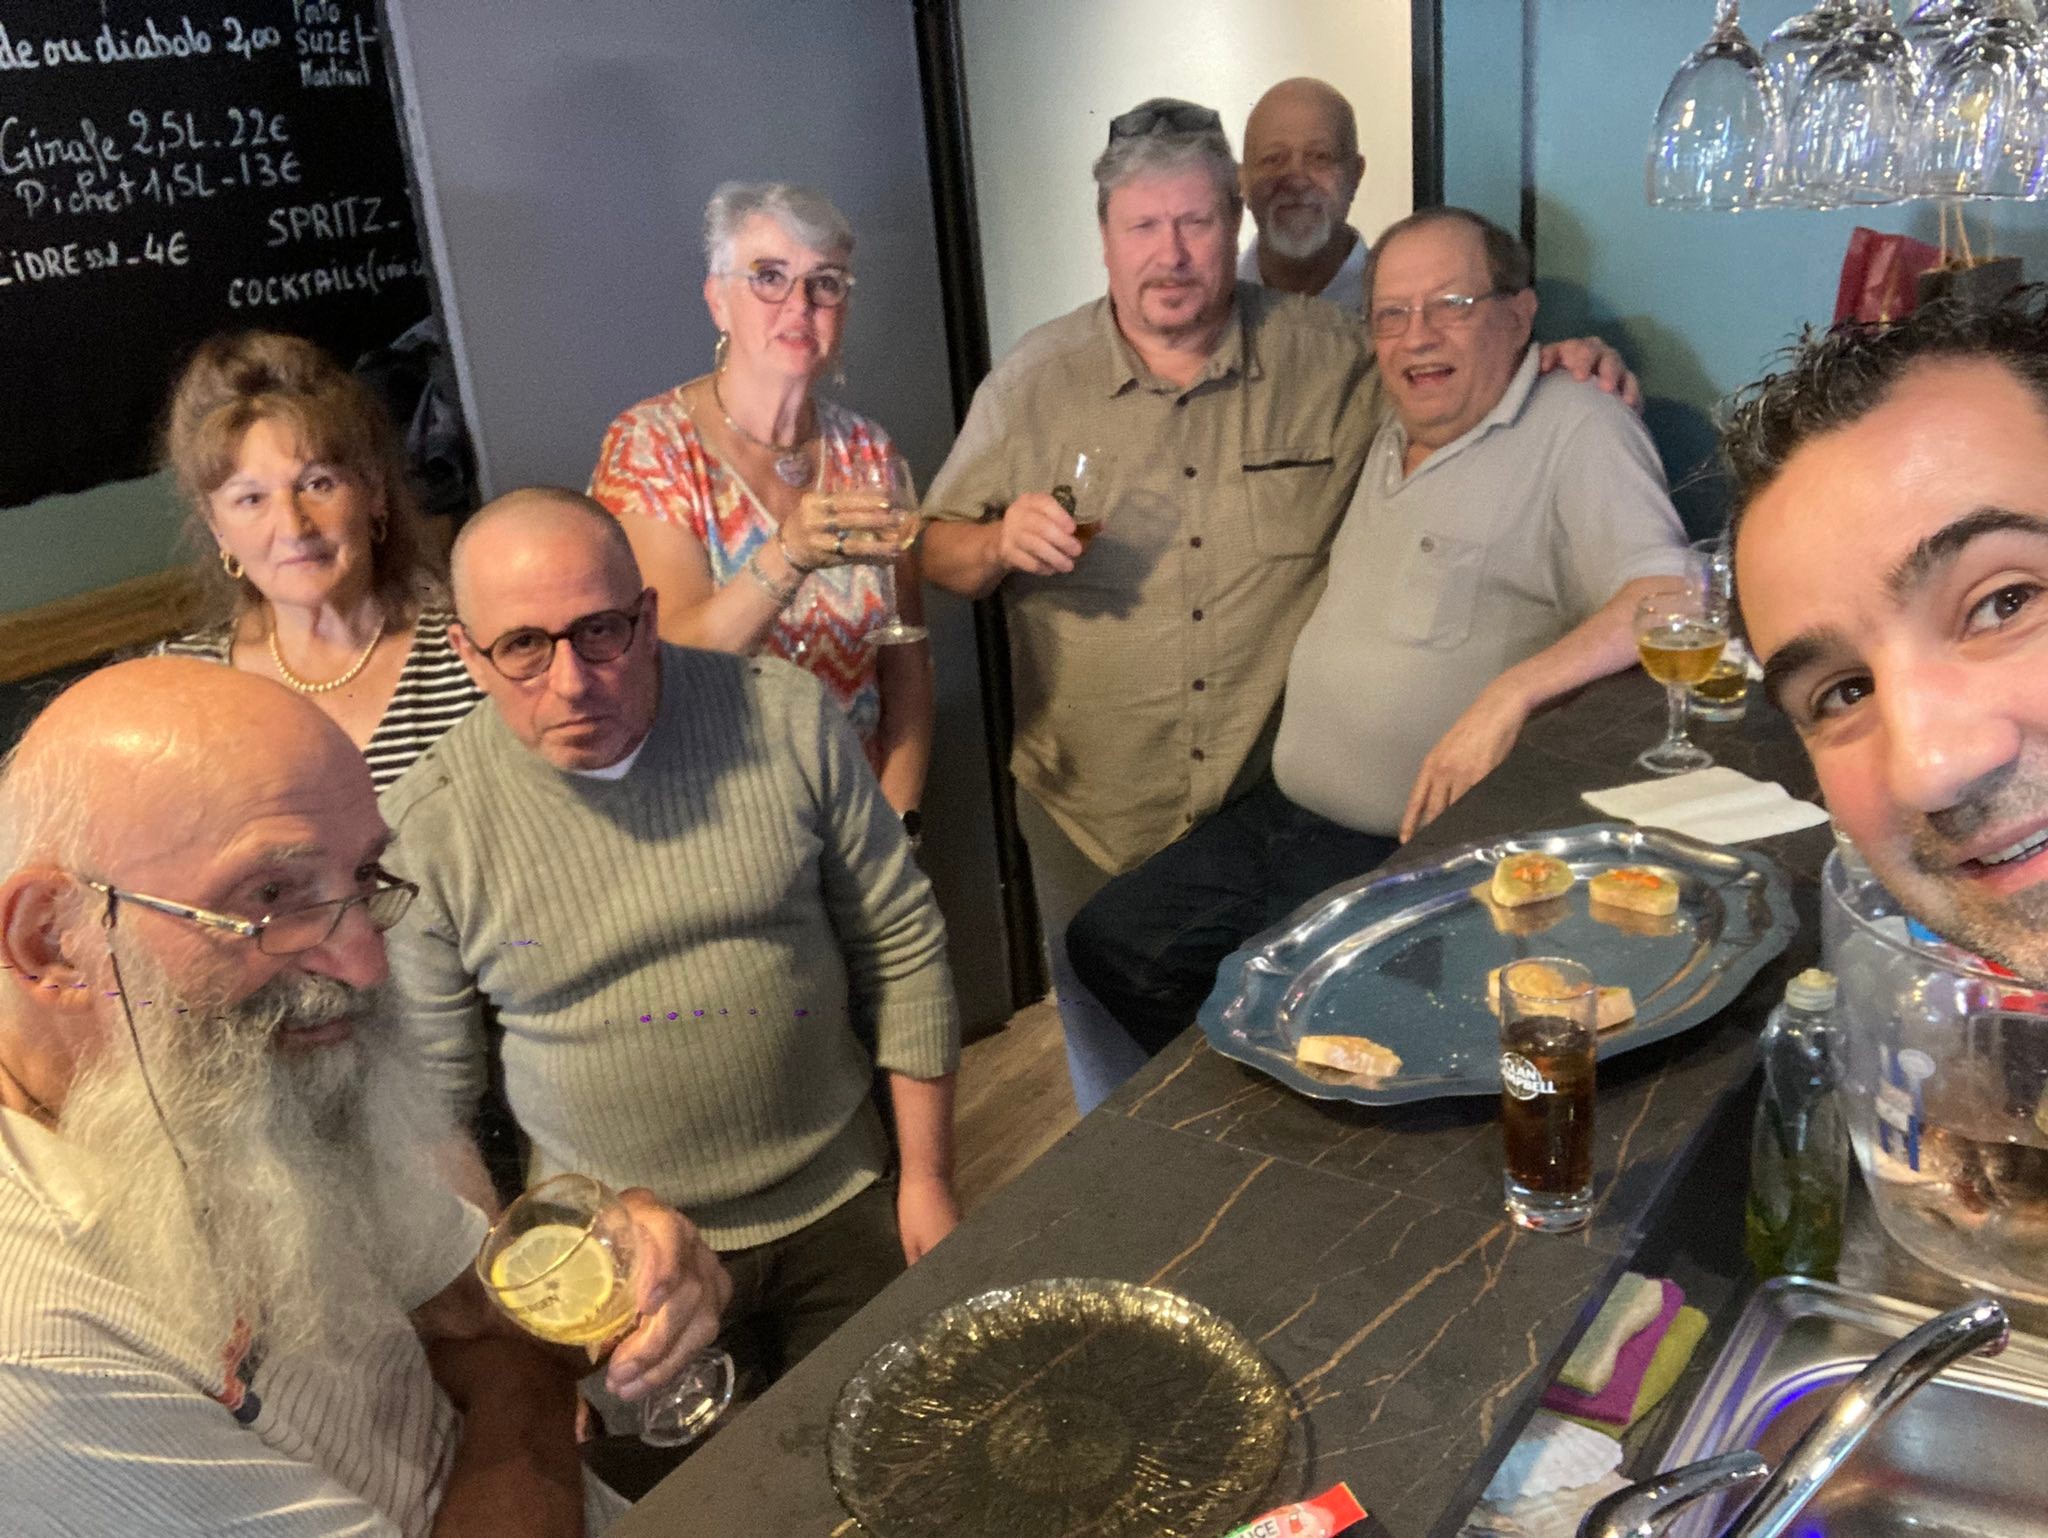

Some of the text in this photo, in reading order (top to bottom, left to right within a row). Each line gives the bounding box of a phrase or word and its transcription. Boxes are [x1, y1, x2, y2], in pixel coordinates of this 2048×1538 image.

[43, 38, 92, 67] ou
[95, 15, 212, 63] diabolo
[295, 27, 350, 55] SUZE
[0, 116, 122, 181] Girafe
[15, 169, 136, 218] Pichet
